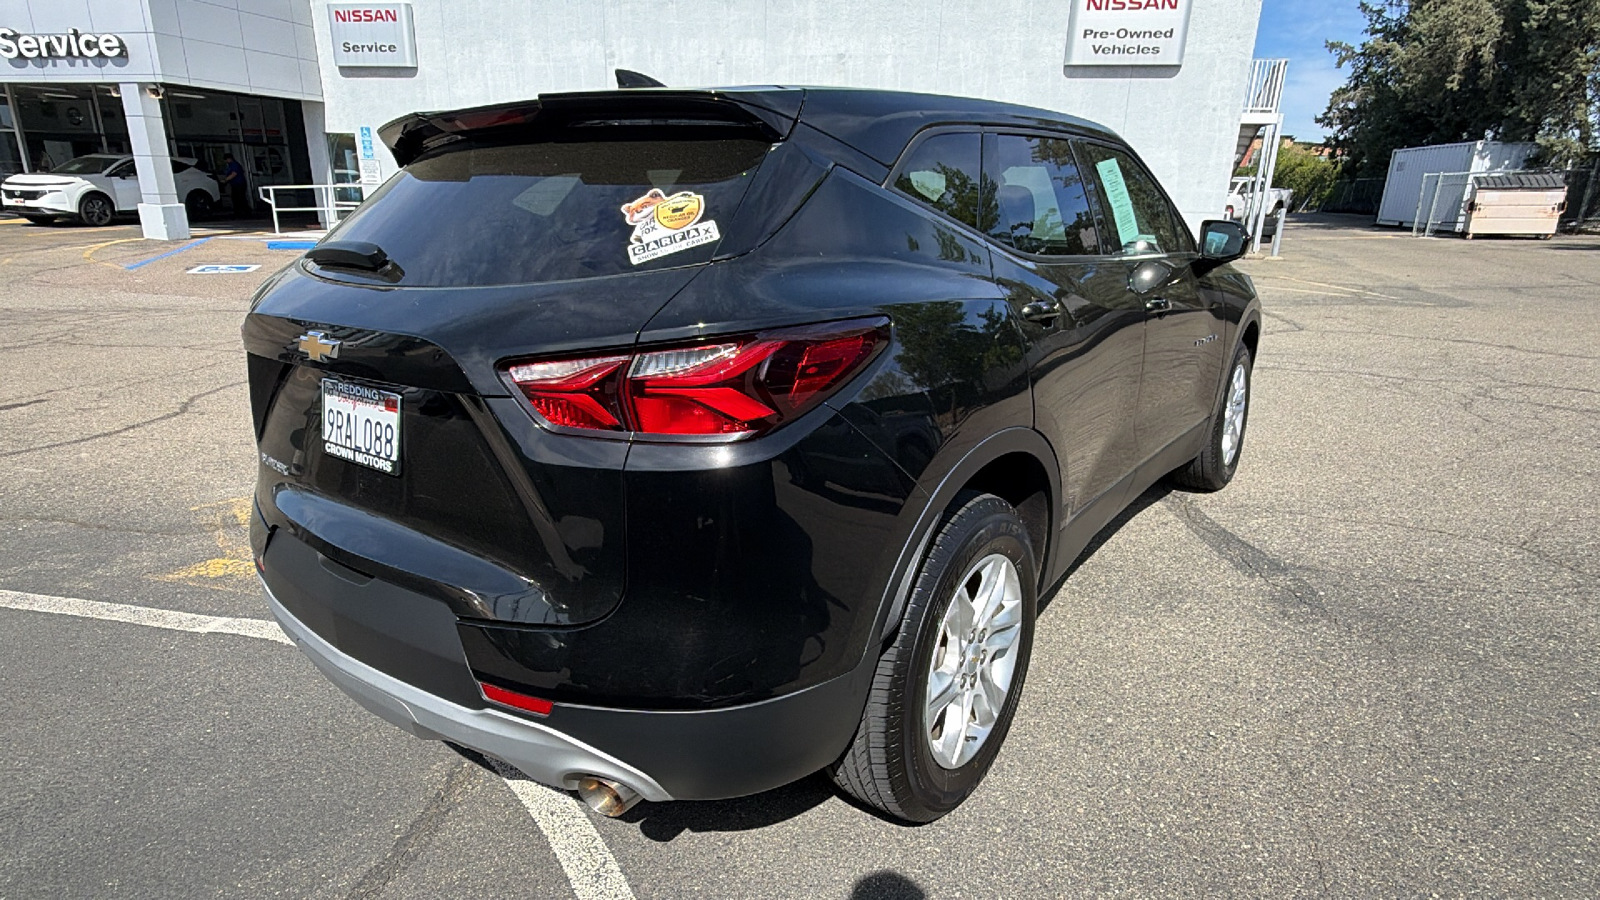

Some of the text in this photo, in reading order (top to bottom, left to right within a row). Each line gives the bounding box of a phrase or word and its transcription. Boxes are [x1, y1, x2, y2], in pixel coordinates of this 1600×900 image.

[1086, 0, 1179, 11] NISSAN
[334, 9, 397, 22] NISSAN
[1082, 28, 1174, 39] Pre-Owned
[0, 27, 121, 59] Service
[342, 42, 397, 53] Service
[1092, 44, 1161, 55] Vehicles
[632, 226, 711, 257] CARFAX
[337, 383, 379, 400] REDDING
[328, 408, 394, 459] 9RAL088
[325, 442, 393, 472] CROWN MOTORS
